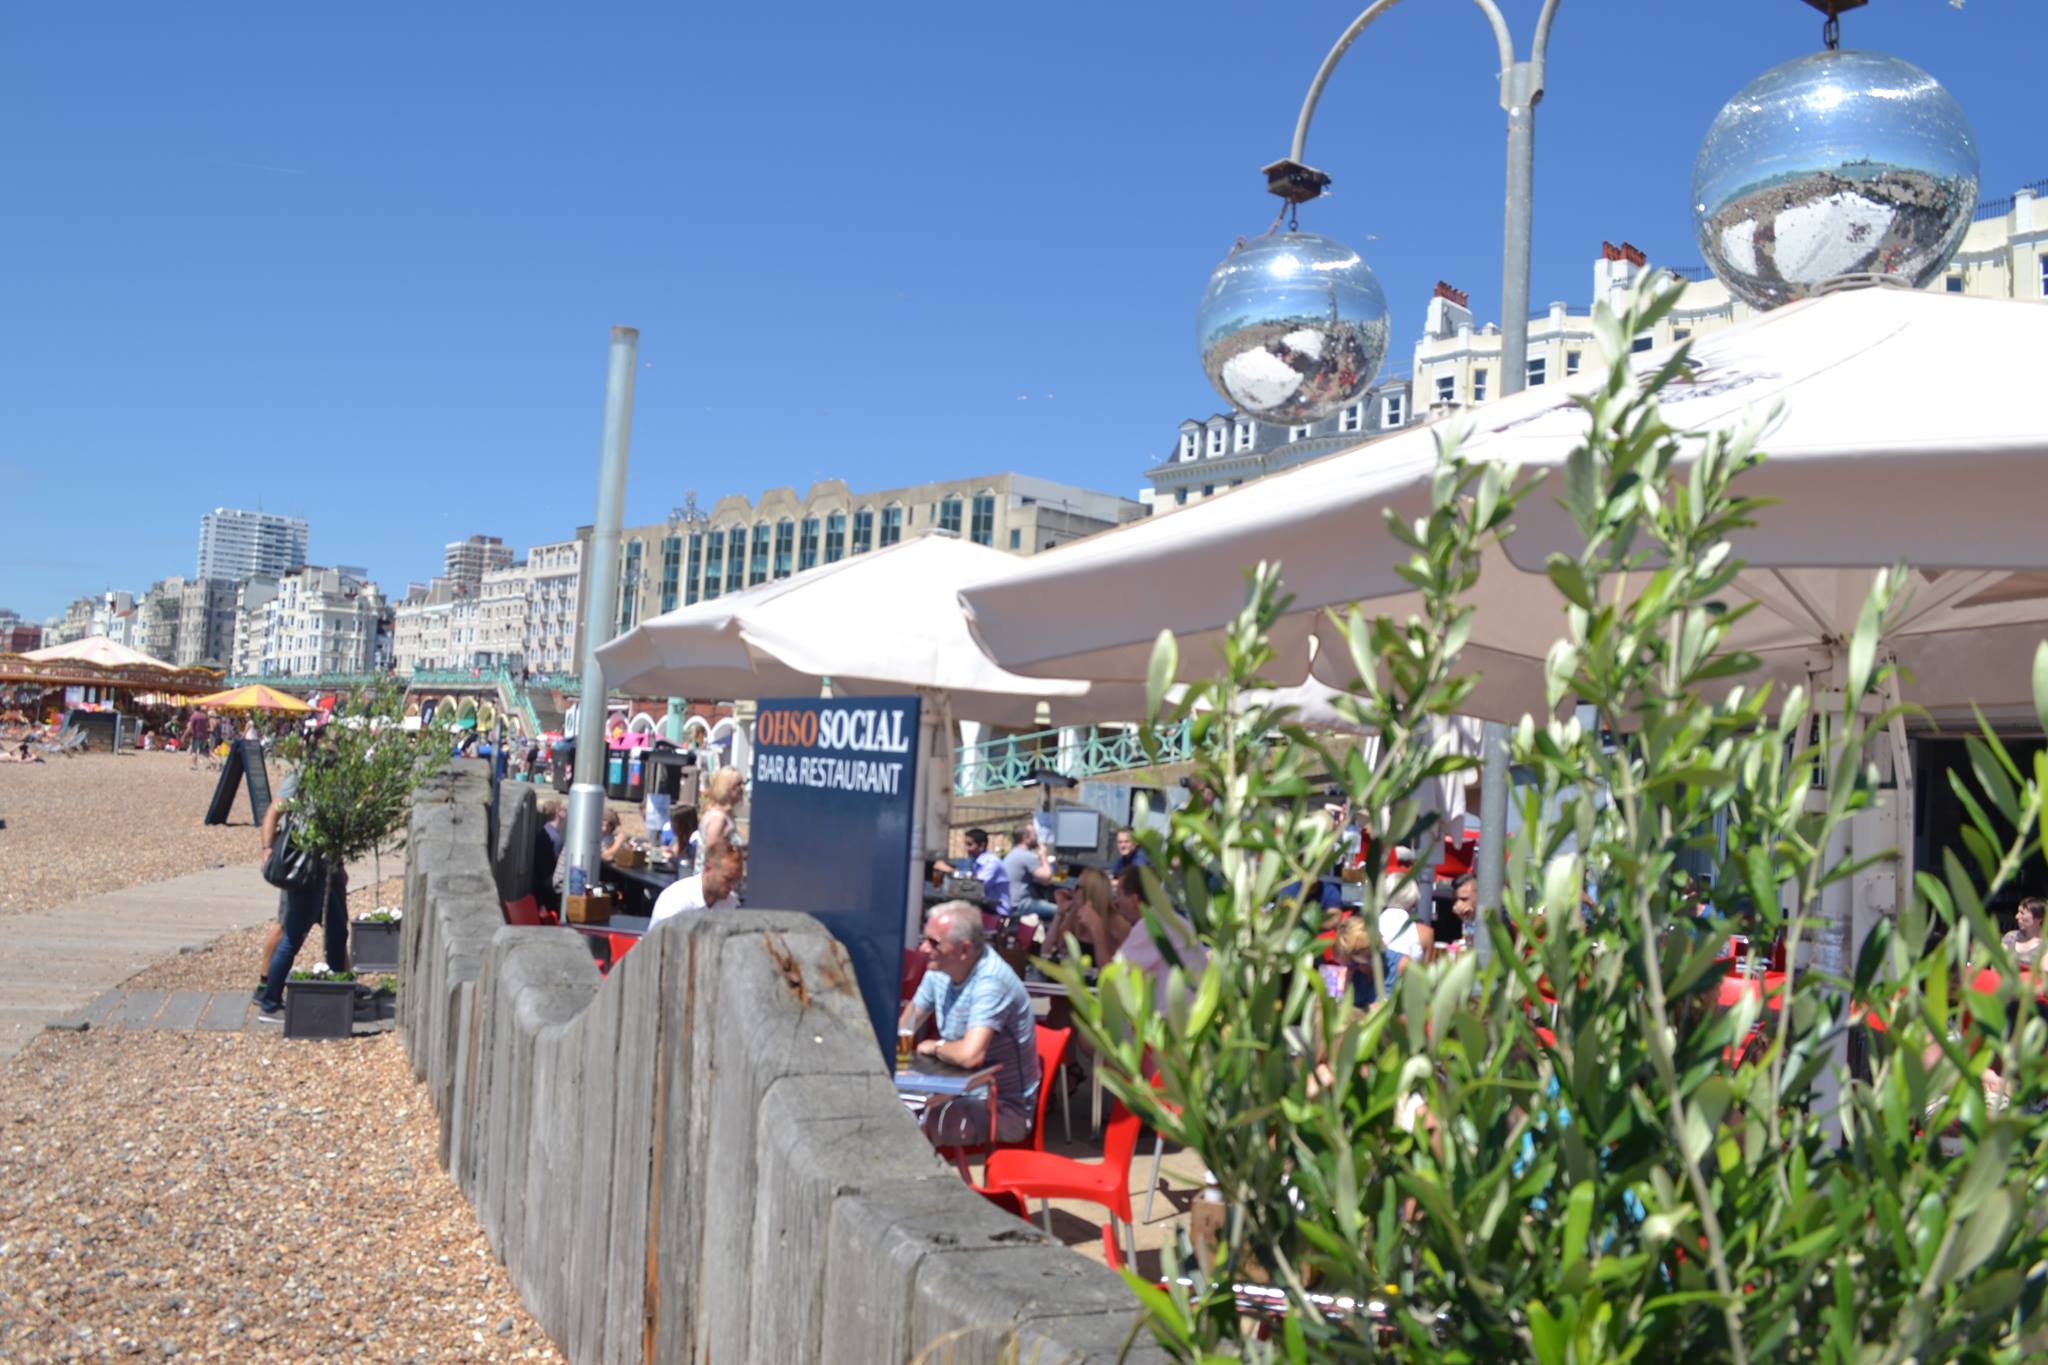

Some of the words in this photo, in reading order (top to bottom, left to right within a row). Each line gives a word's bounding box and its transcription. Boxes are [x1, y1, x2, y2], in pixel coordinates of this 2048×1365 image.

[758, 709, 818, 748] OHSO
[818, 709, 909, 752] SOCIAL
[757, 754, 785, 783] BAR
[785, 756, 798, 785] &
[800, 757, 903, 795] RESTAURANT
